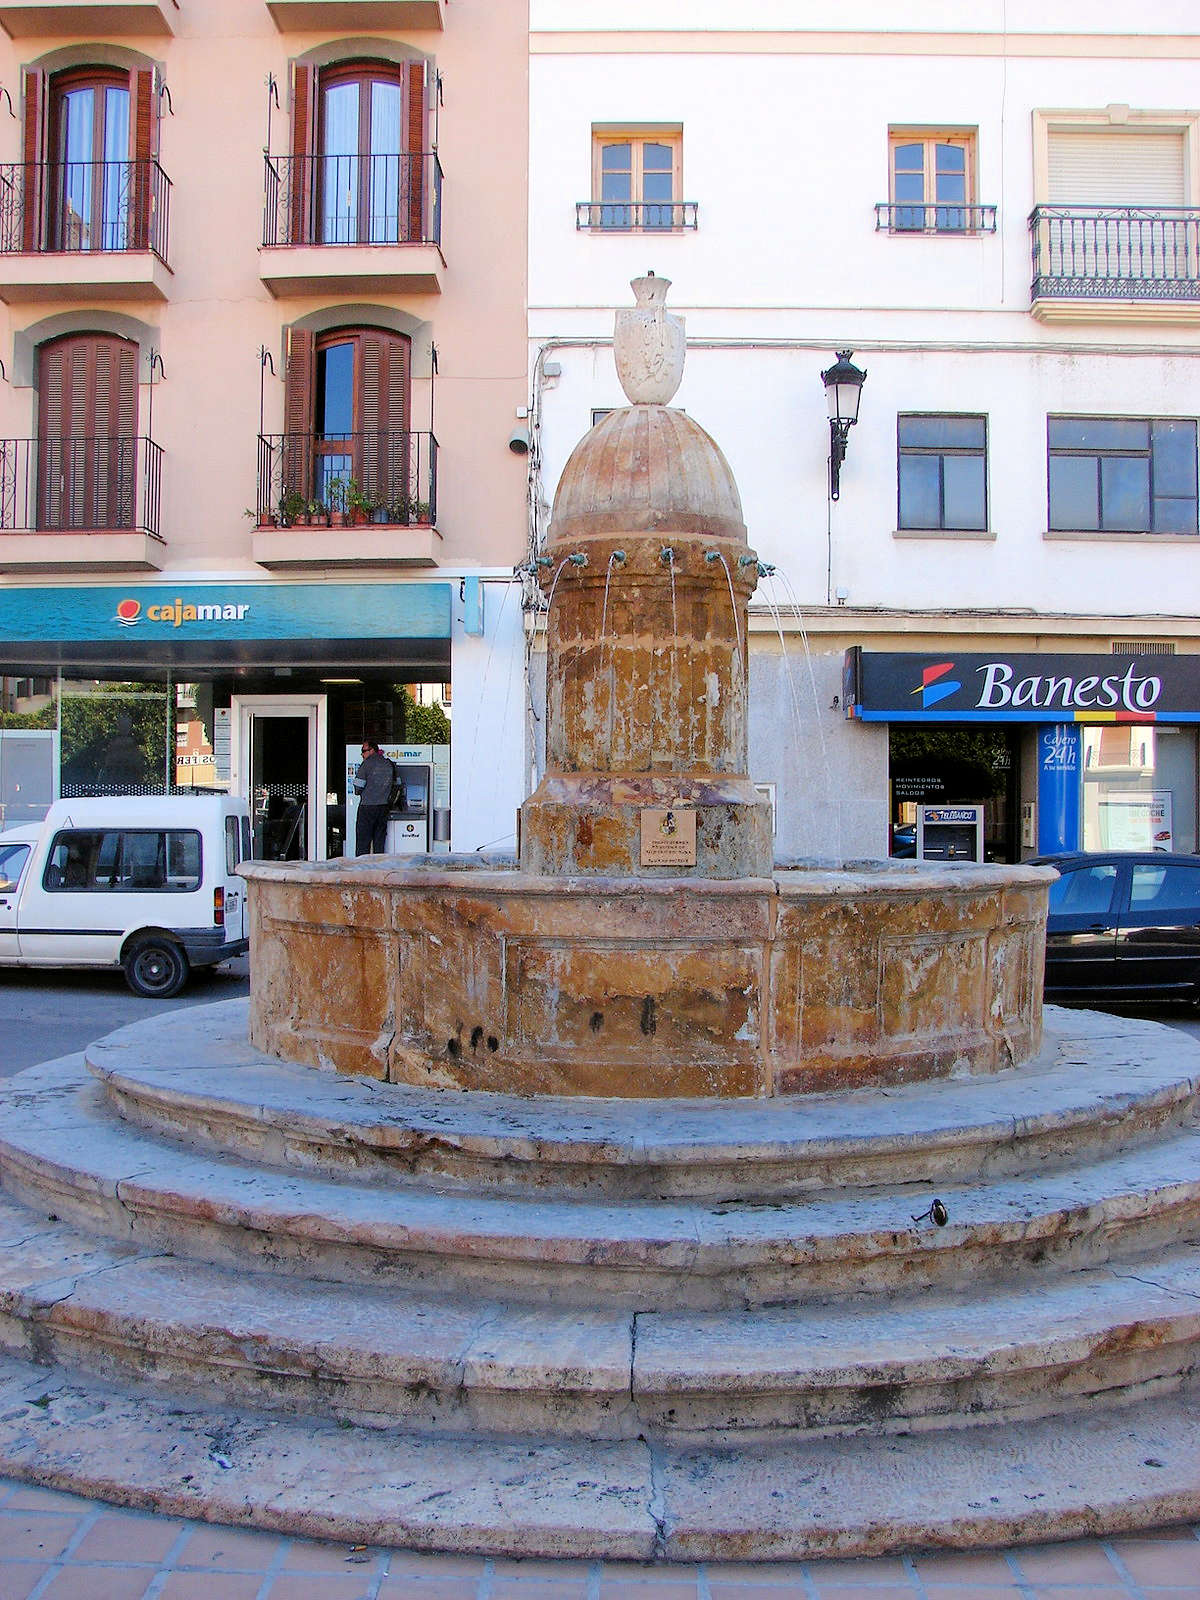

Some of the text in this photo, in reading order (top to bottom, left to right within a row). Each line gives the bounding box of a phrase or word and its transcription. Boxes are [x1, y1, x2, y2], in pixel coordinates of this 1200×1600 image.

[147, 598, 250, 628] cajamar
[975, 662, 1162, 714] Banesto
[1043, 734, 1077, 746] Cajero
[386, 750, 422, 759] cajamar
